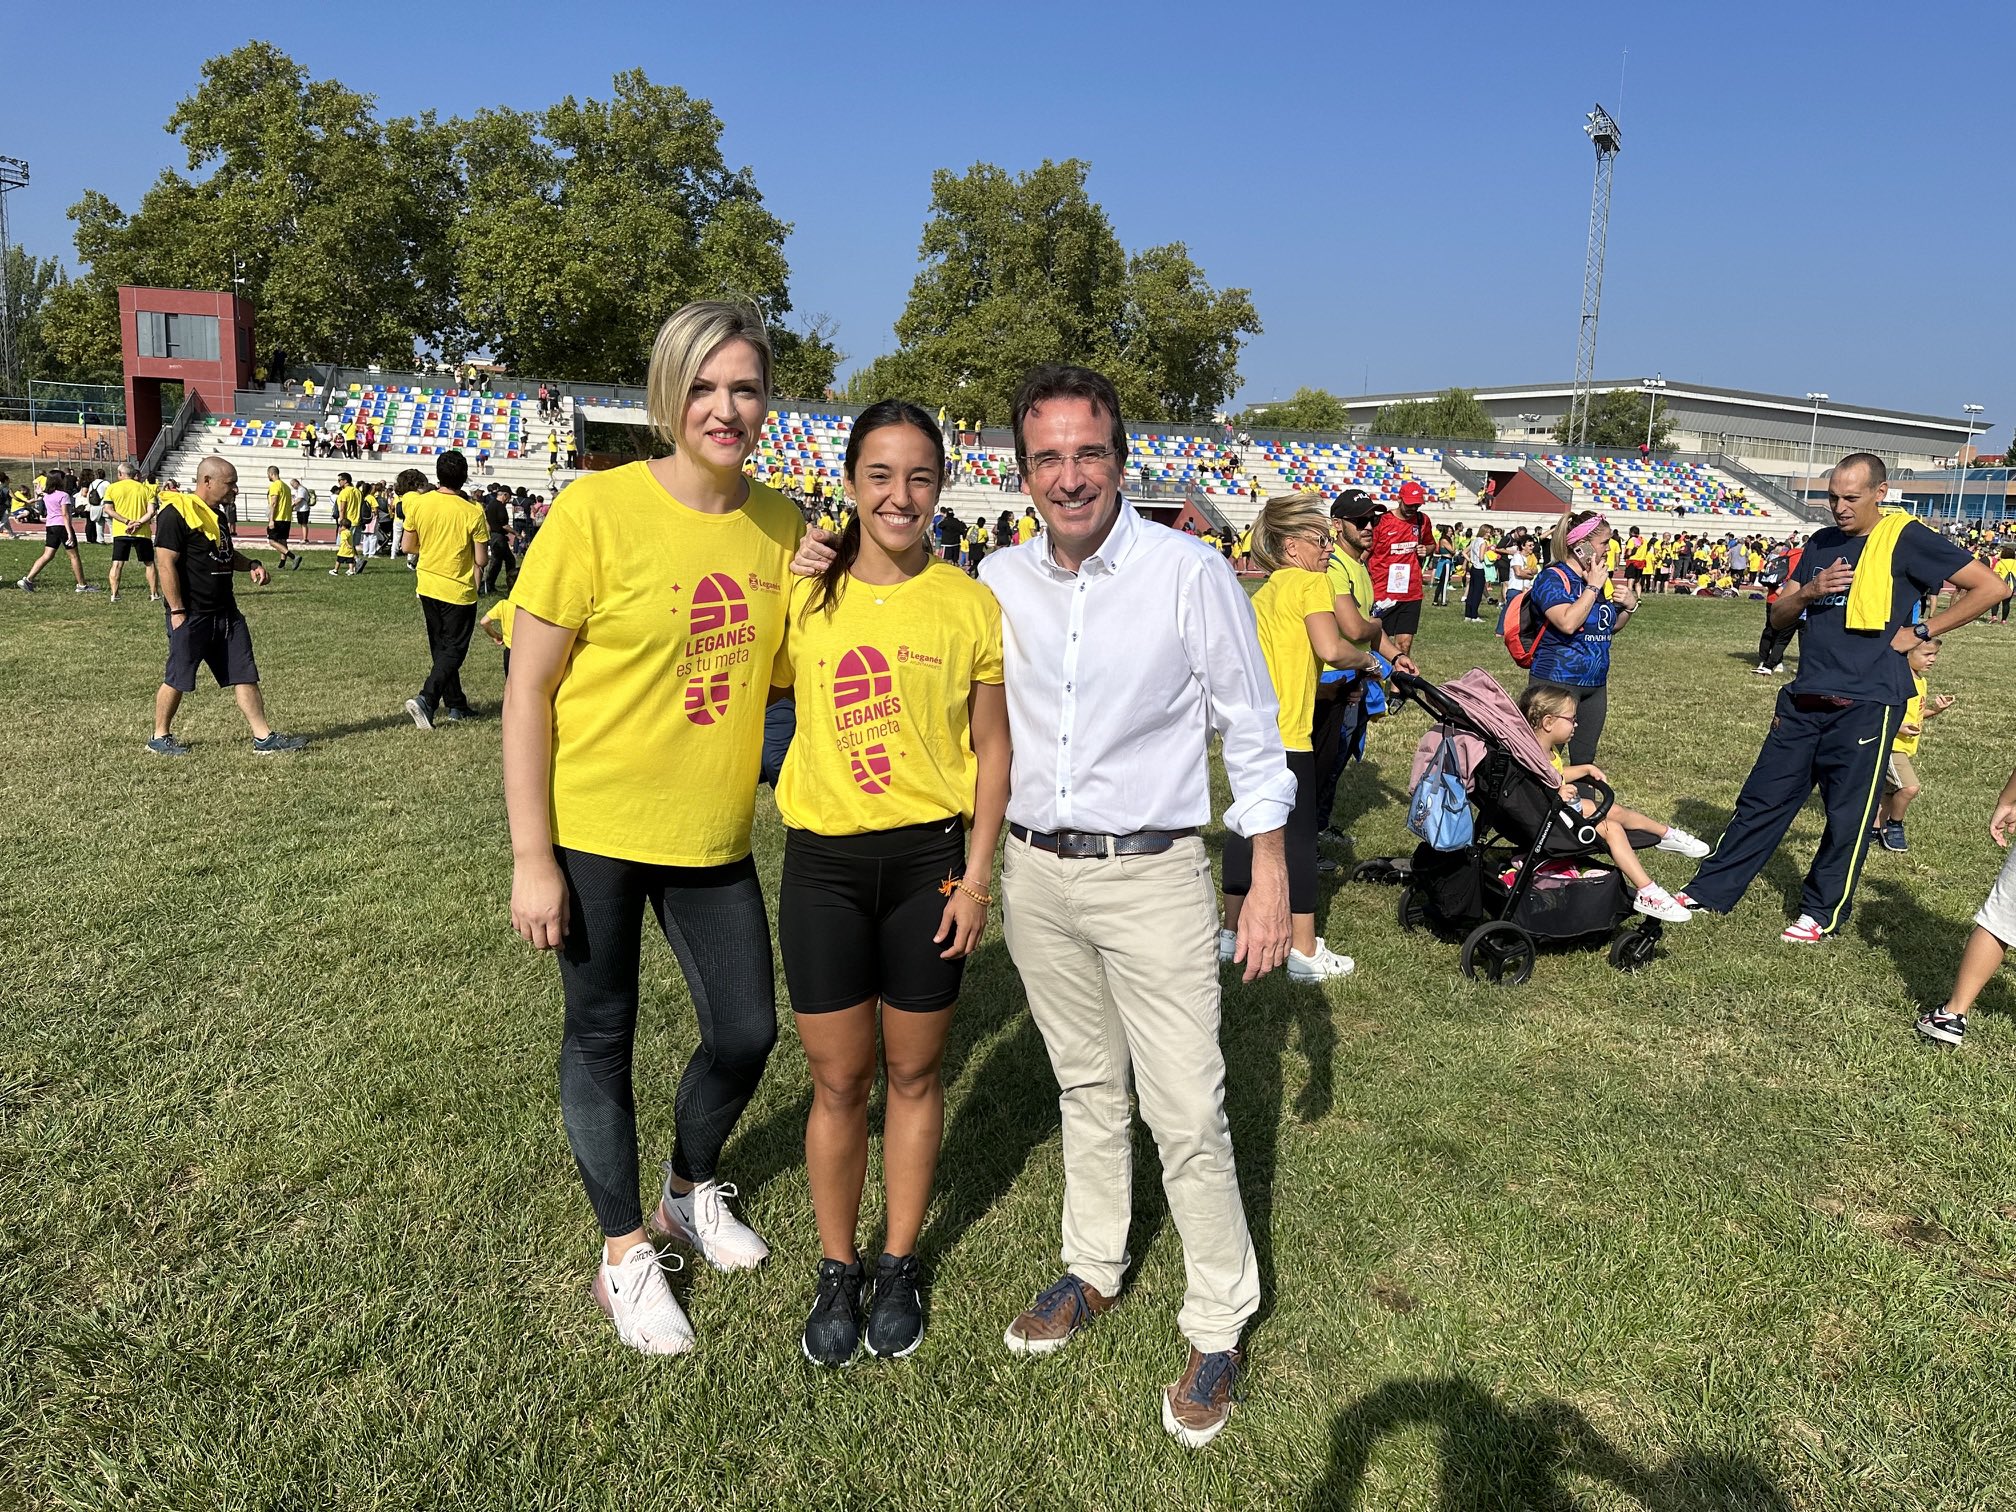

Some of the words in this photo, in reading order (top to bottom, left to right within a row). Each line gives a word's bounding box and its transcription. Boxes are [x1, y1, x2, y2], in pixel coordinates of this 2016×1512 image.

[685, 623, 756, 658] LEGANÉS
[1584, 634, 1606, 642] RIYADH
[676, 662, 692, 677] es
[697, 657, 711, 672] tu
[715, 649, 749, 669] meta
[910, 651, 943, 665] Leganés
[835, 695, 902, 732] LEGANÉS
[836, 735, 850, 752] es
[849, 730, 863, 747] tu
[867, 718, 901, 742] meta
